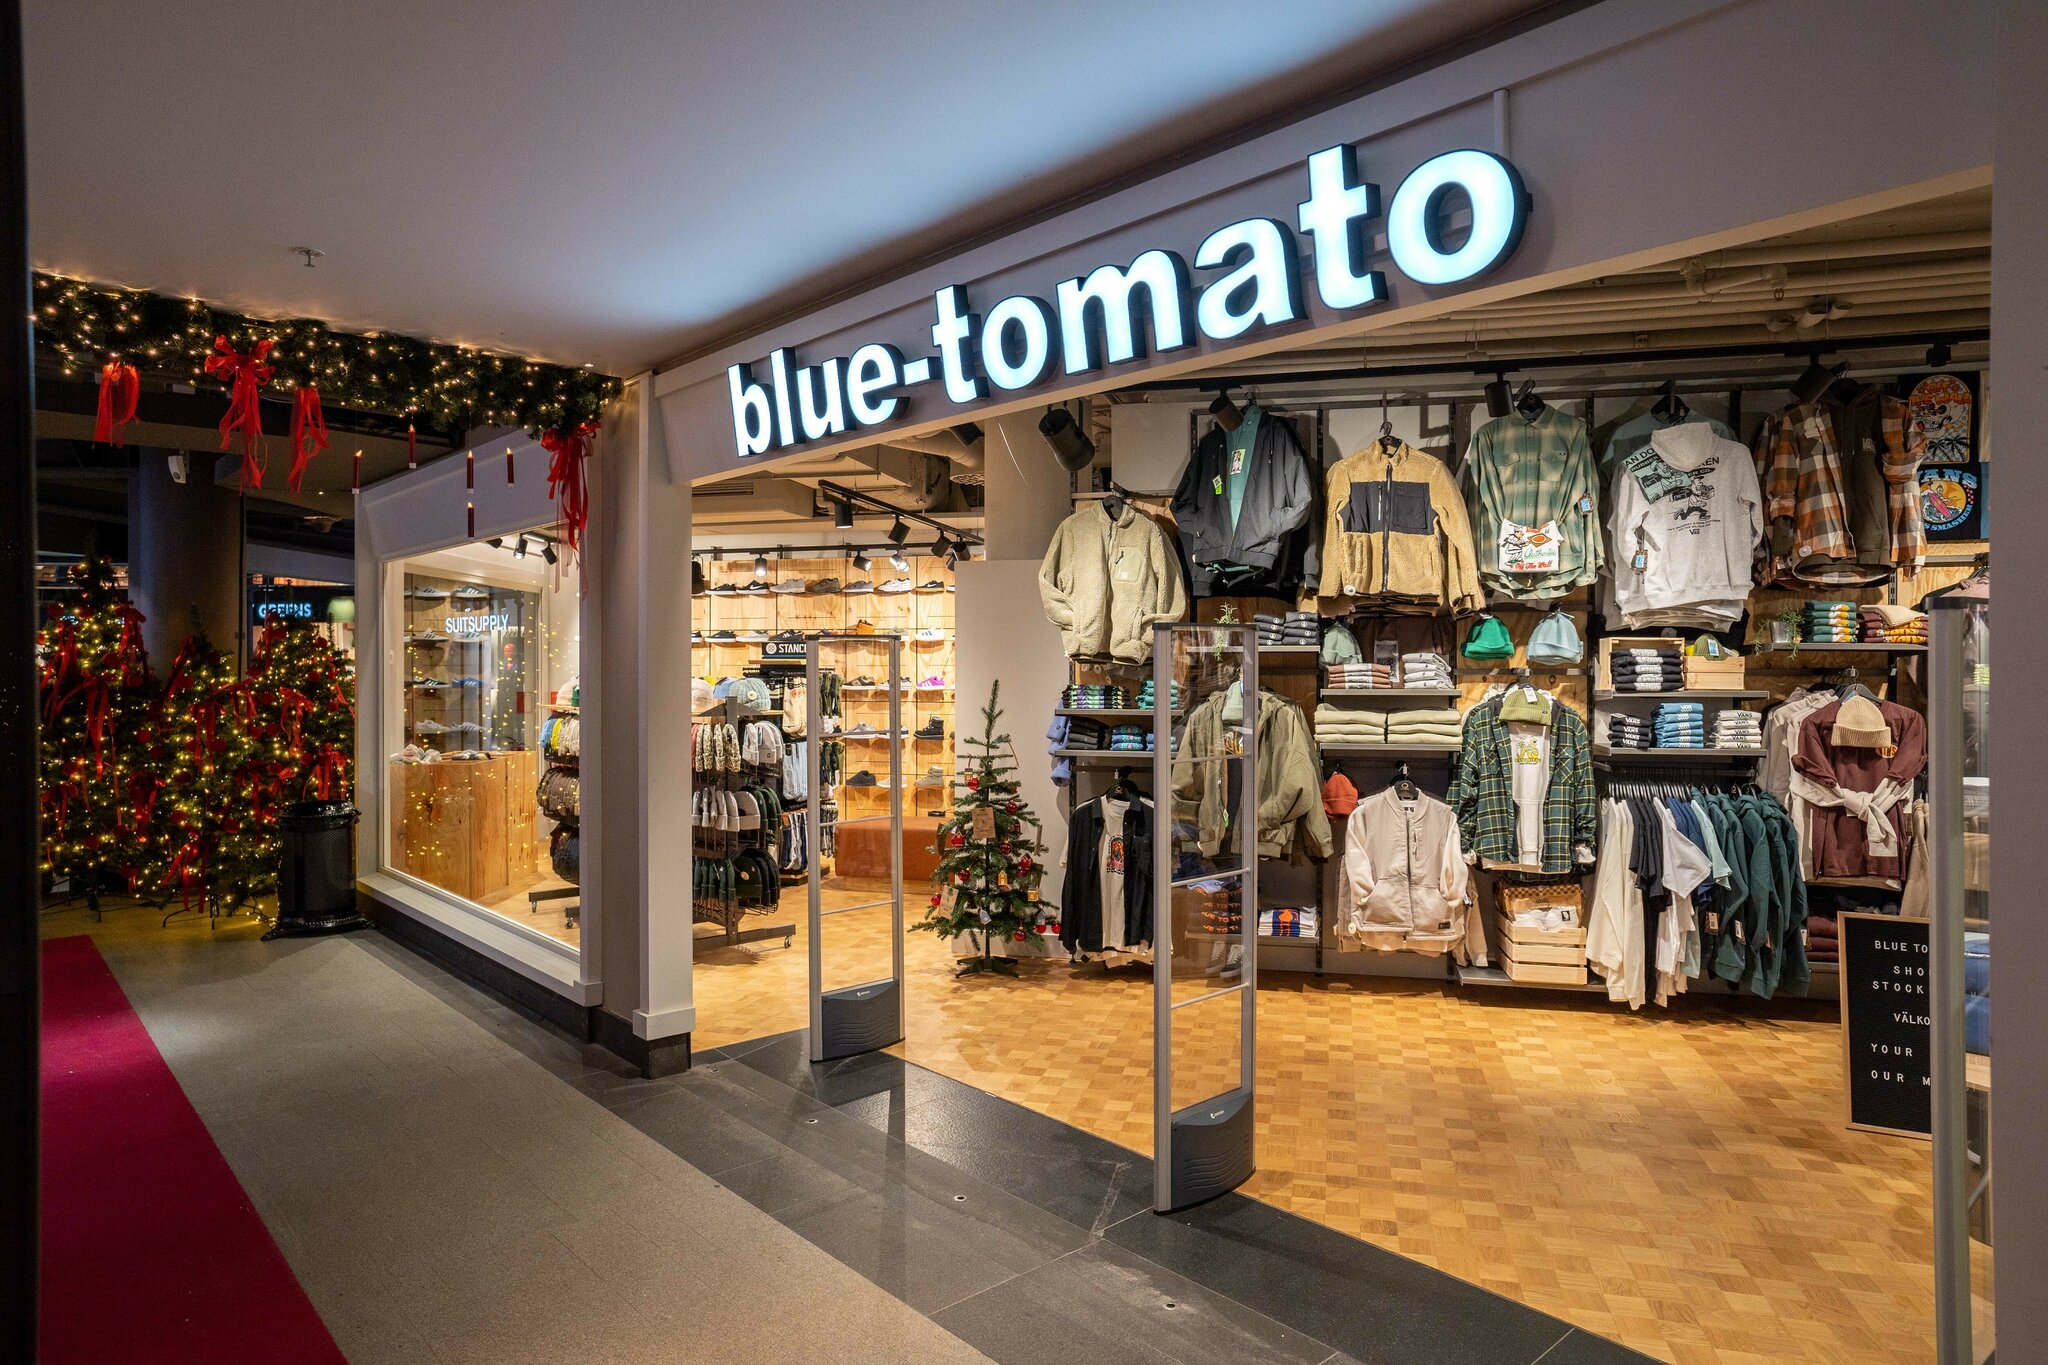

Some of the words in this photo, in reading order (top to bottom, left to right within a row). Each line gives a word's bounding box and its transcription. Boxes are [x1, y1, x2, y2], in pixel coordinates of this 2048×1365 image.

[727, 143, 1526, 458] blue-tomato
[445, 613, 509, 634] SUITSUPPLY
[1874, 940, 1908, 952] BLUE
[1872, 980, 1924, 994] STOCK
[1870, 1043, 1913, 1057] YOUR
[1871, 1069, 1904, 1083] OUR
